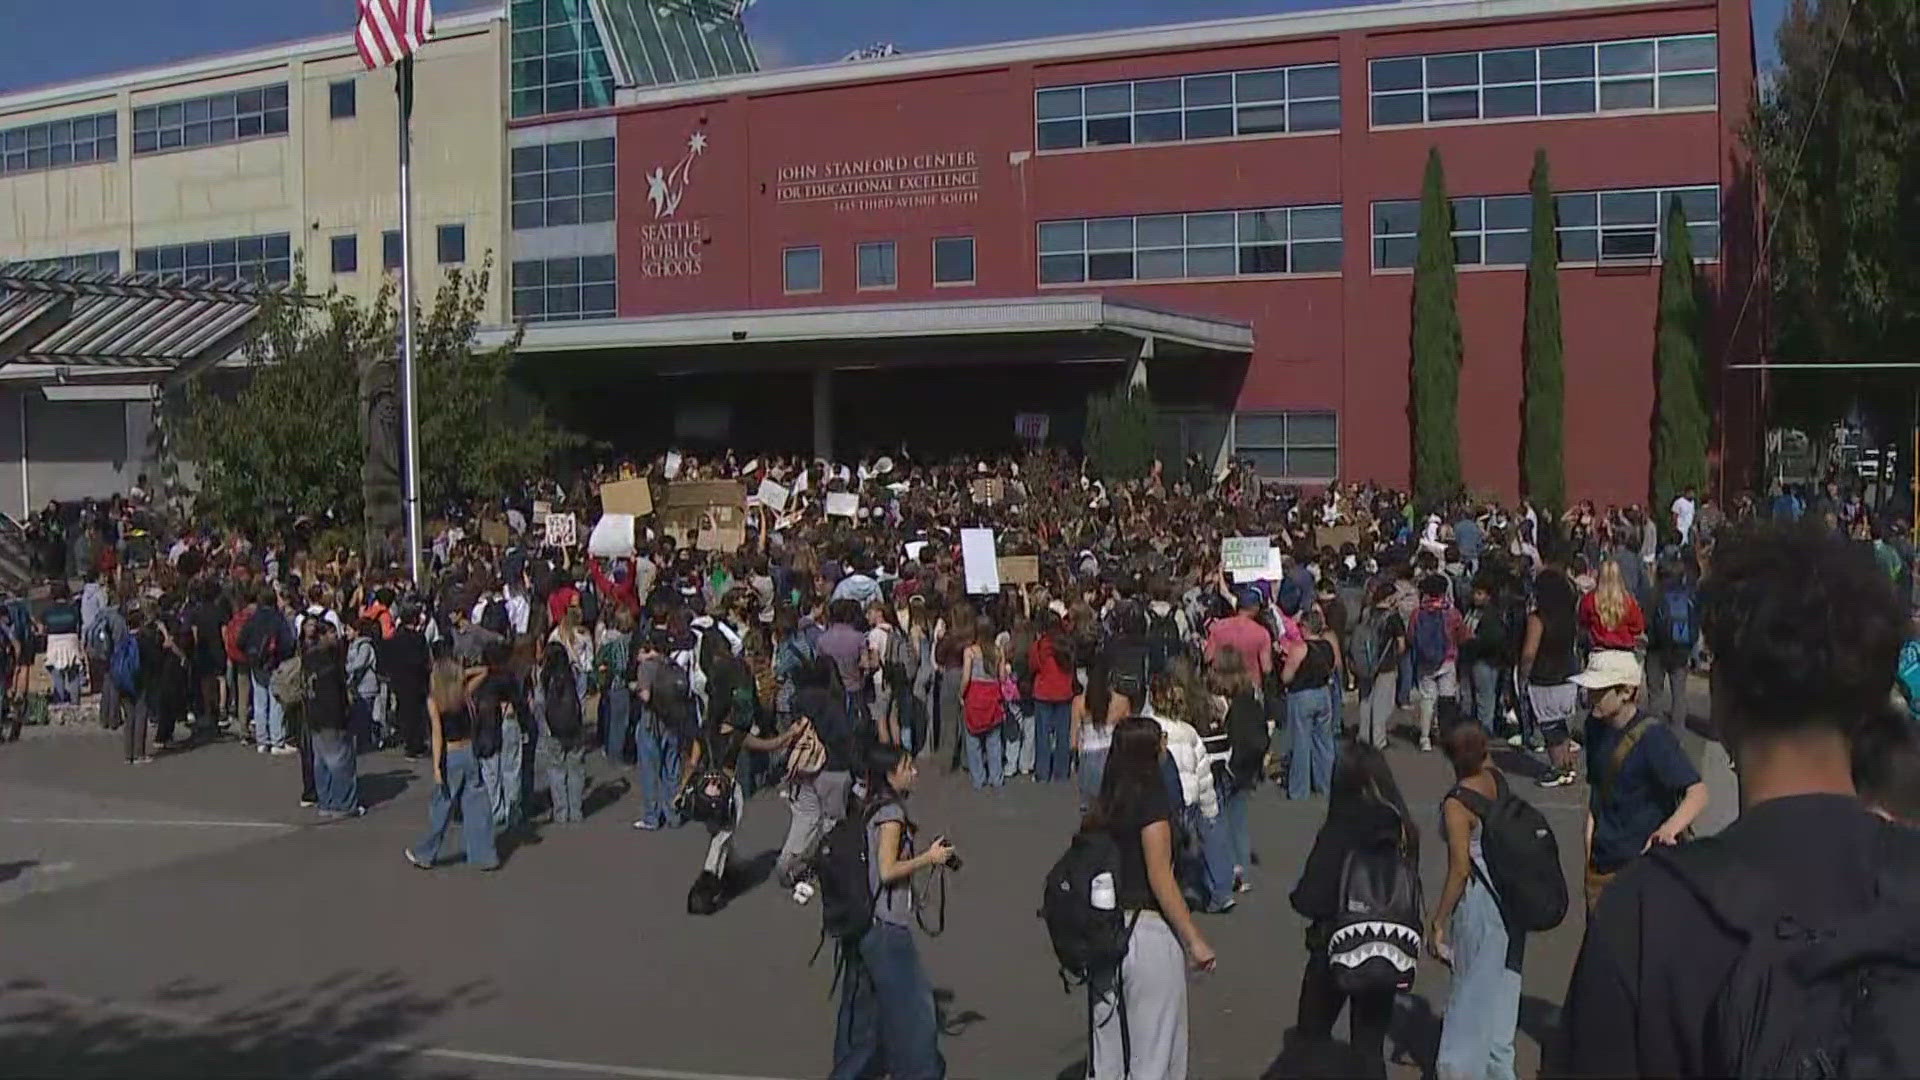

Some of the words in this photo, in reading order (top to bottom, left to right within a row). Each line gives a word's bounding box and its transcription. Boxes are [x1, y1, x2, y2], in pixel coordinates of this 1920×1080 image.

[778, 164, 817, 182] JOHN
[824, 157, 908, 177] STANFORD
[913, 152, 976, 169] CENTER
[777, 186, 801, 200] FOR
[805, 180, 892, 198] EDUCATIONAL
[900, 171, 976, 189] EXCELLENCE
[860, 198, 894, 210] THIRD
[896, 195, 936, 207] AVENUE
[939, 191, 978, 203] SOUTH
[641, 222, 700, 240] SEATTLE
[641, 241, 701, 259] PUBLIC
[641, 260, 702, 277] SCHOOLS
